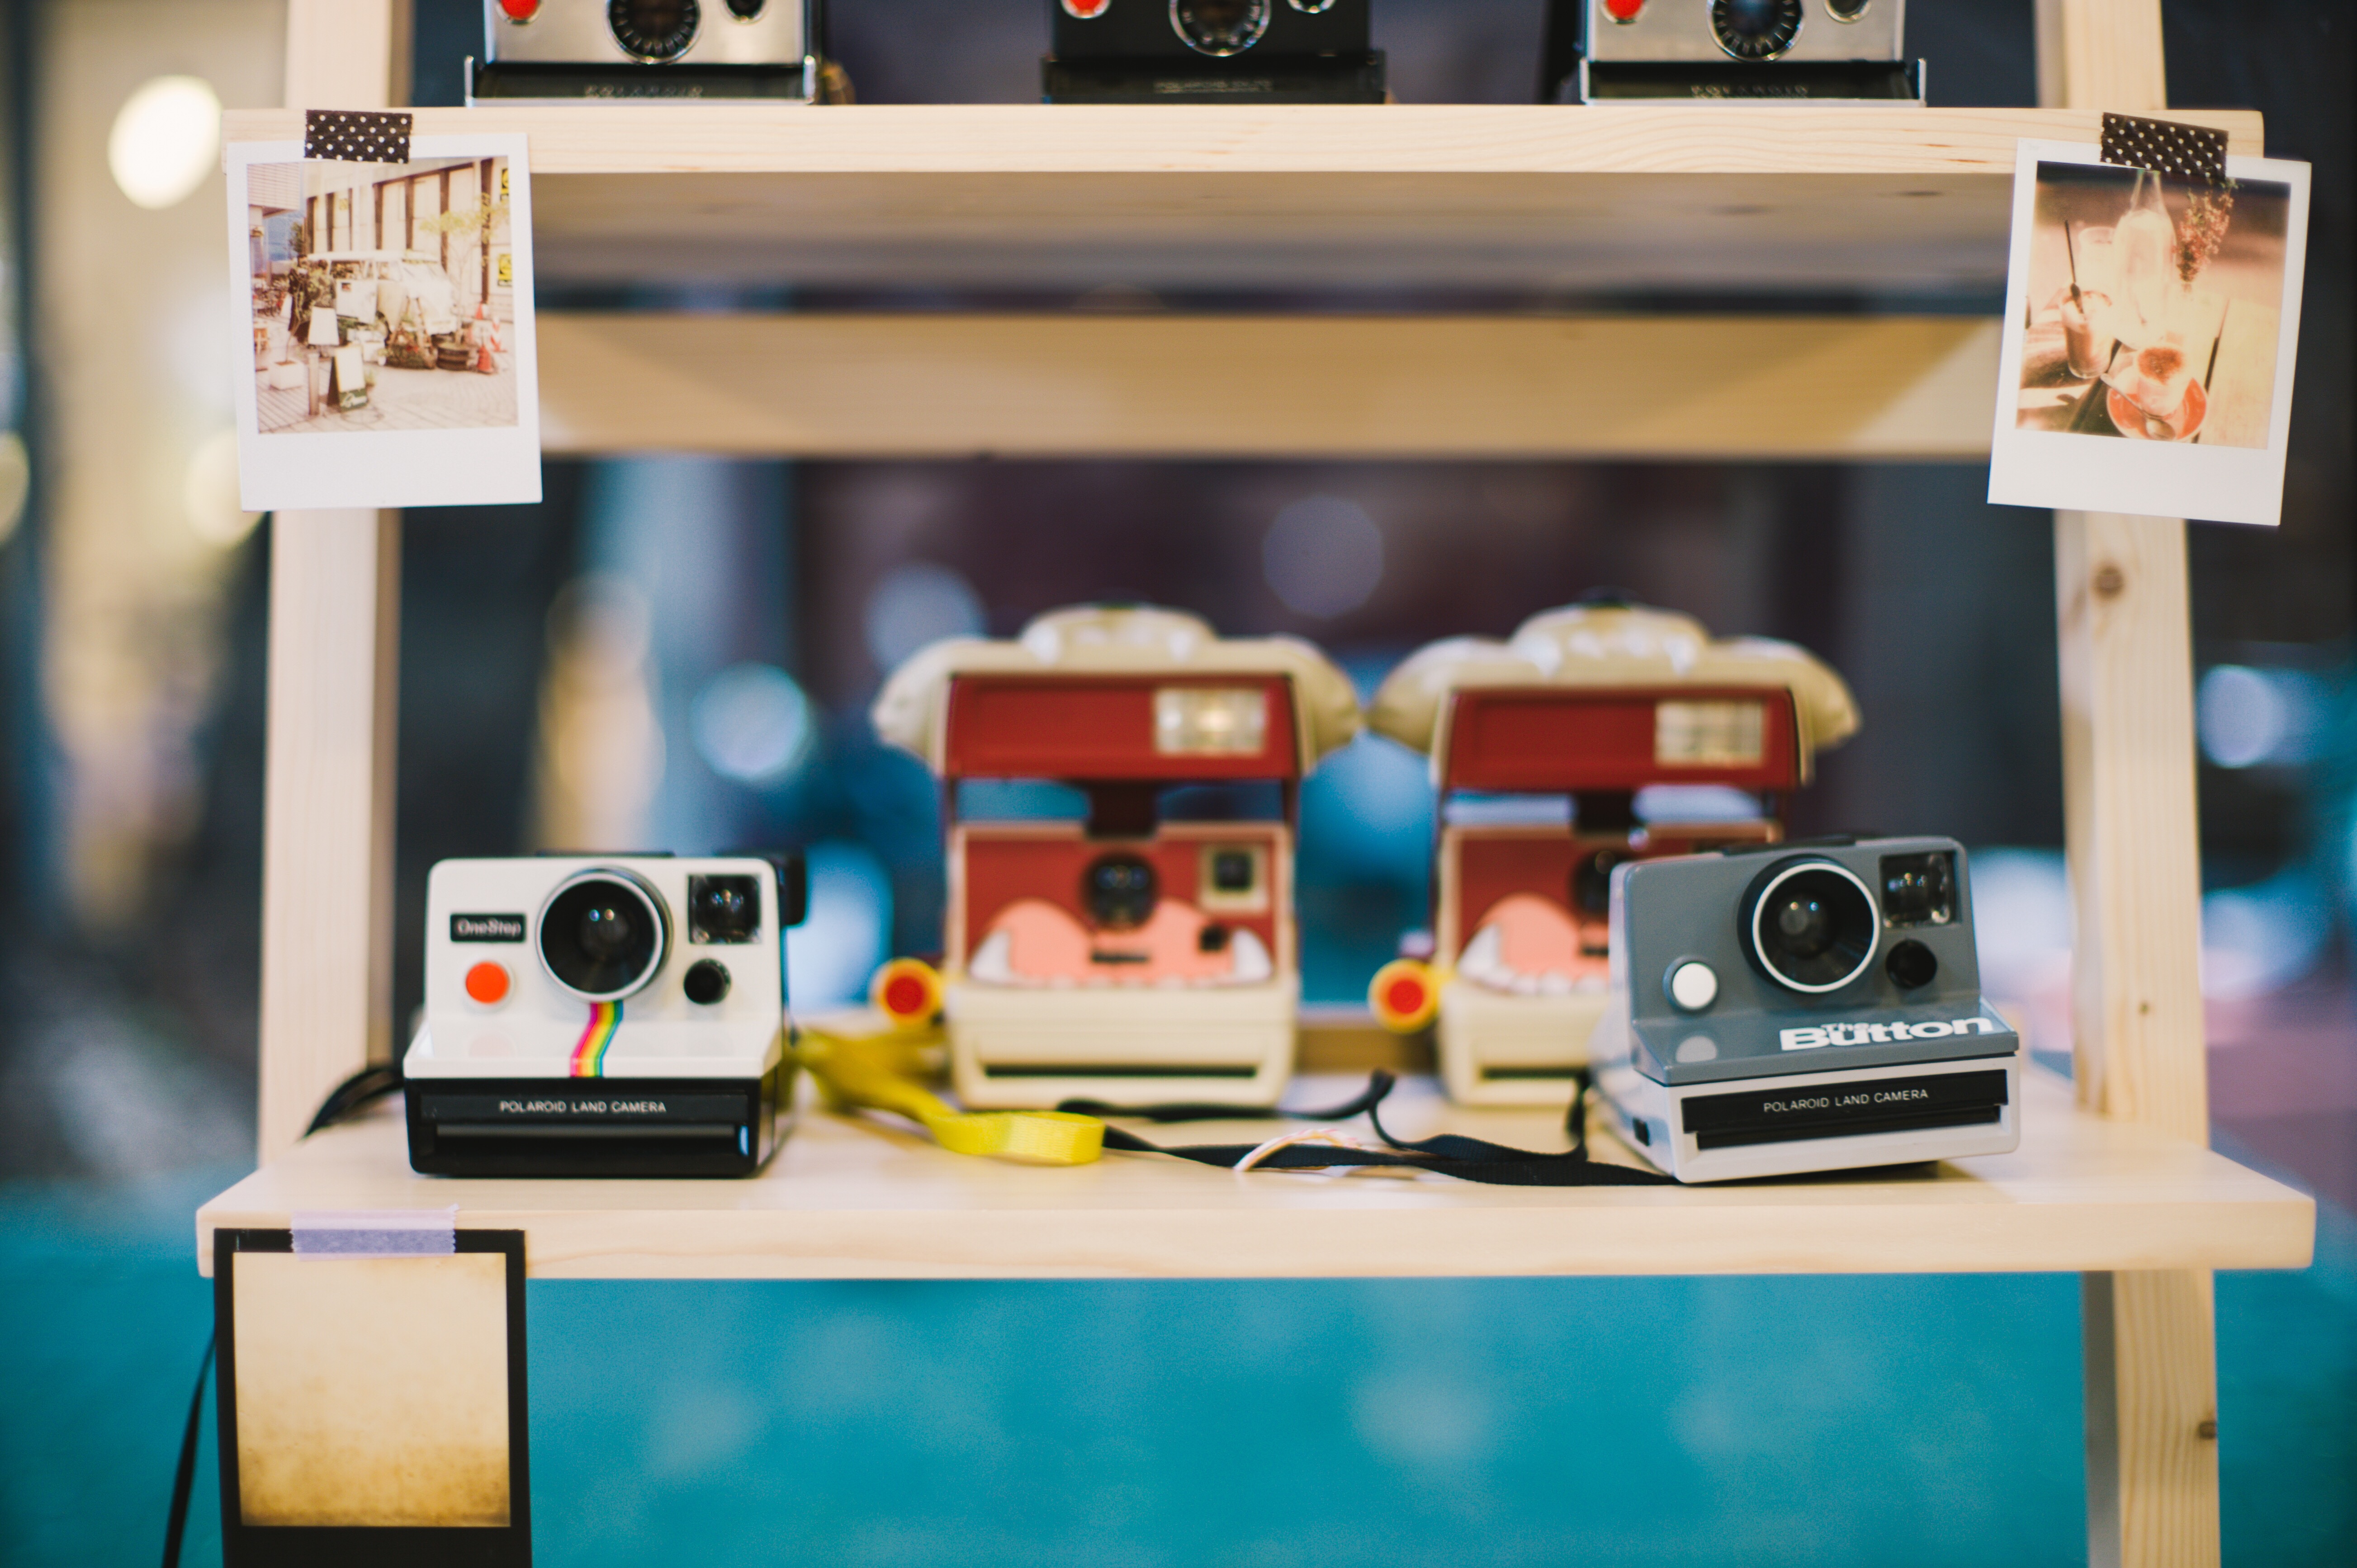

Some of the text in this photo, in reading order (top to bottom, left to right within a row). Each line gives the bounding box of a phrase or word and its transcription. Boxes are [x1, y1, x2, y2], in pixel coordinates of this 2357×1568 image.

[457, 918, 521, 937] OneStep
[1780, 1017, 1993, 1051] Button
[499, 1100, 667, 1113] POLAROID LAND CAMERA
[1763, 1089, 1928, 1113] POLAROID LAND CAMERA
